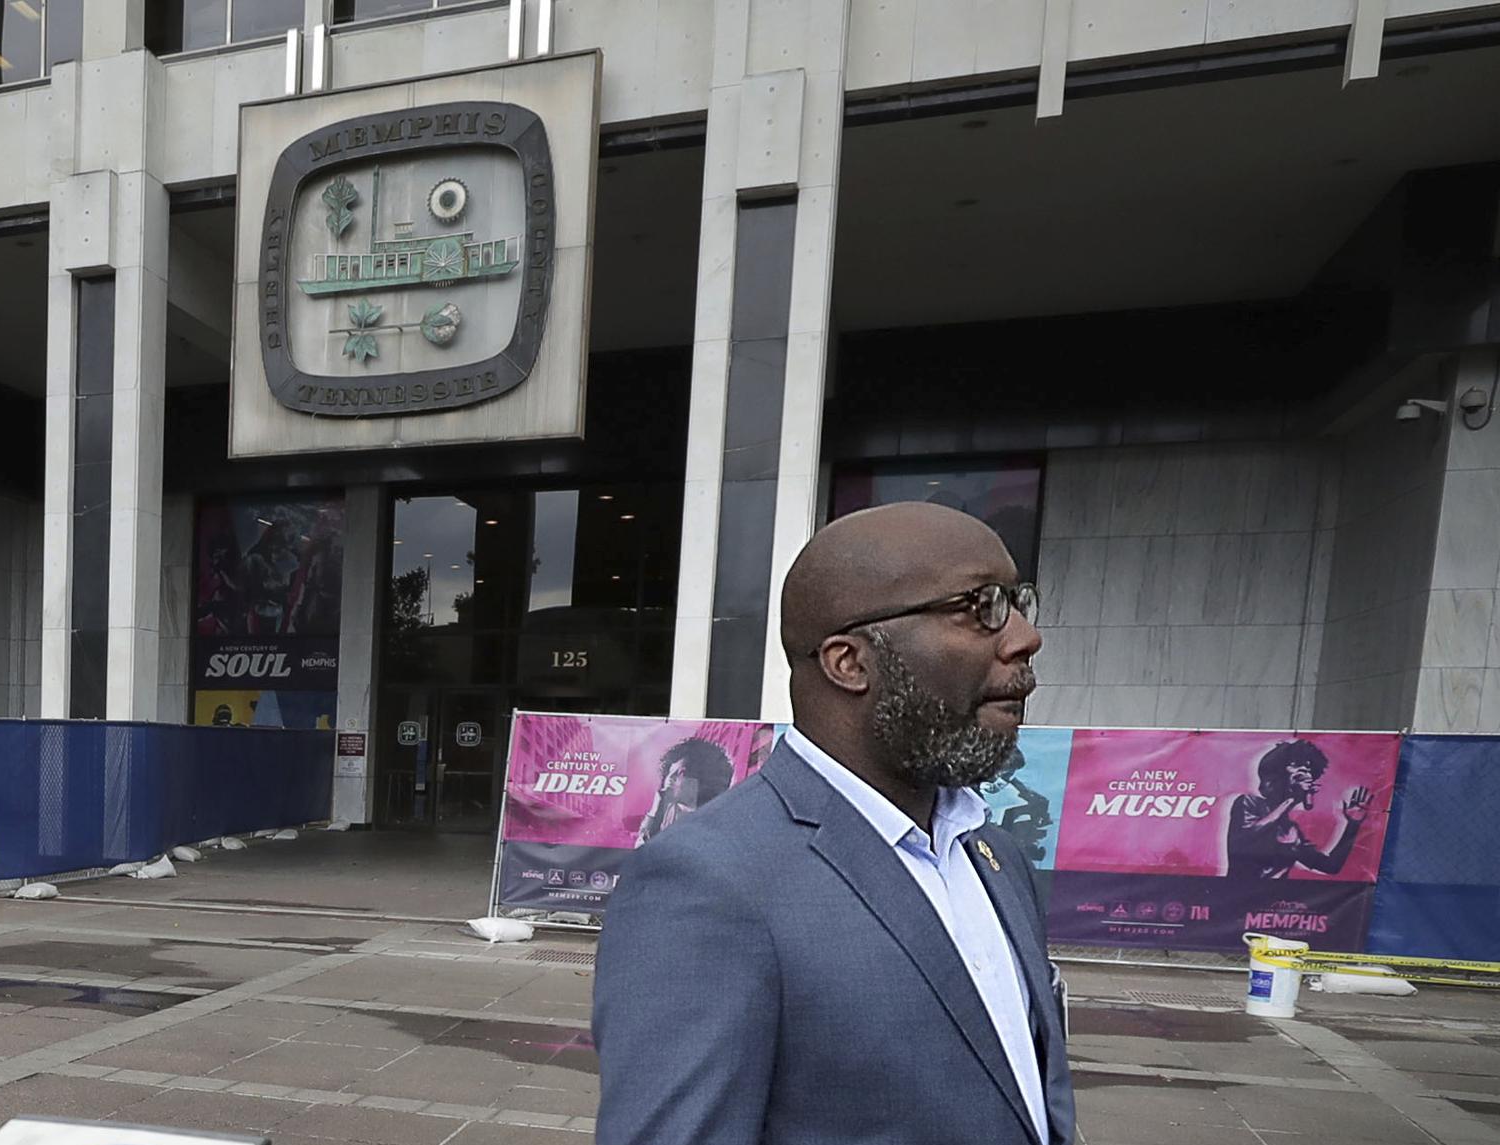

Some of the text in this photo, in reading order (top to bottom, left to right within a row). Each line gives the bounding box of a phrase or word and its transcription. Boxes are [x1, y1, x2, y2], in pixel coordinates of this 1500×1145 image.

[309, 111, 508, 162] MEMPHIS
[526, 162, 550, 323] COUNTY
[266, 206, 286, 350] SHELBY
[298, 371, 500, 406] TENNESSEE
[205, 653, 292, 677] SOUL
[301, 658, 337, 668] MEMPHIS
[551, 650, 588, 668] 125
[546, 761, 616, 773] CENTURY OF
[563, 751, 601, 762] A NEW
[533, 772, 628, 796] IDEAS
[1130, 770, 1177, 780] A NEW
[1108, 781, 1197, 792] CENTURY OF
[1085, 794, 1217, 818] MUSIC
[1244, 911, 1329, 932] MEMPHIS
